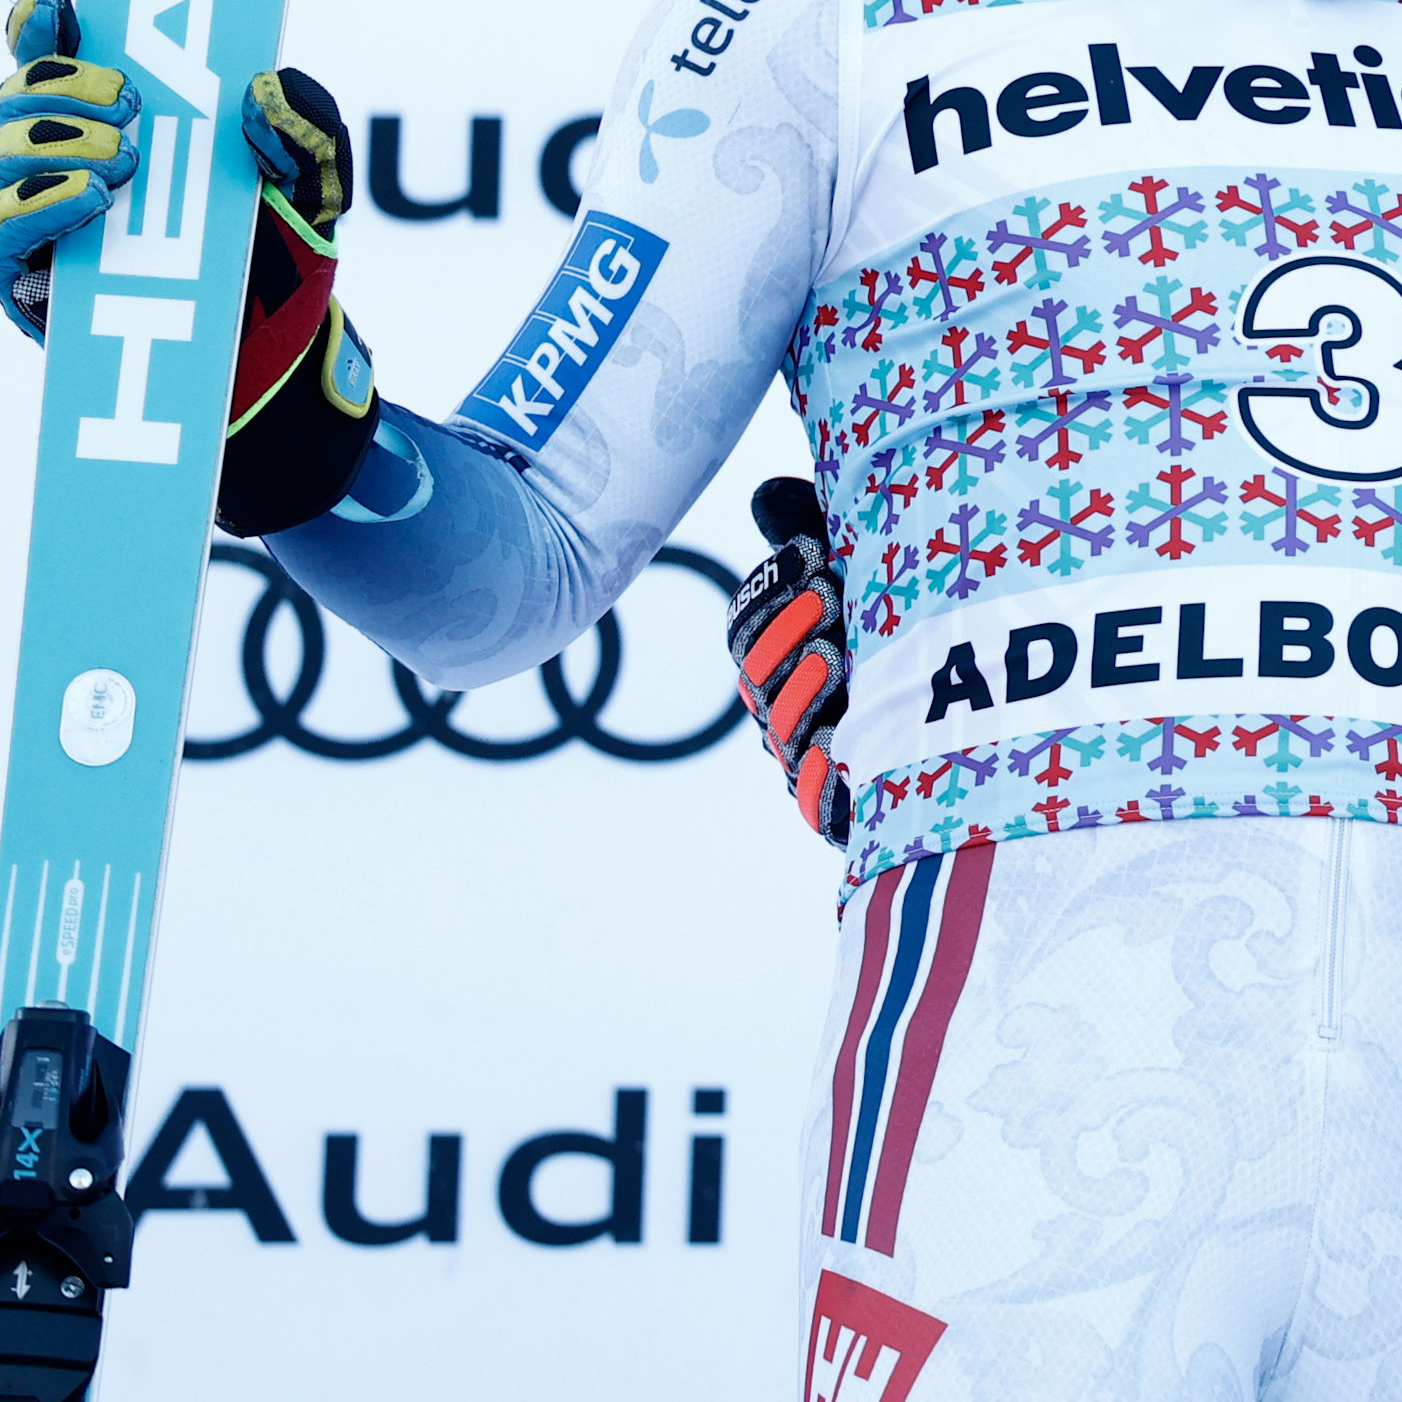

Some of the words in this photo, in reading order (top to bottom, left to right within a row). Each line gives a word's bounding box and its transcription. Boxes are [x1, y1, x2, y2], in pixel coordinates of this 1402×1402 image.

[499, 237, 642, 435] KPMG
[91, 682, 108, 719] EMC
[13, 1127, 43, 1181] 14X
[125, 1085, 727, 1247] Audi
